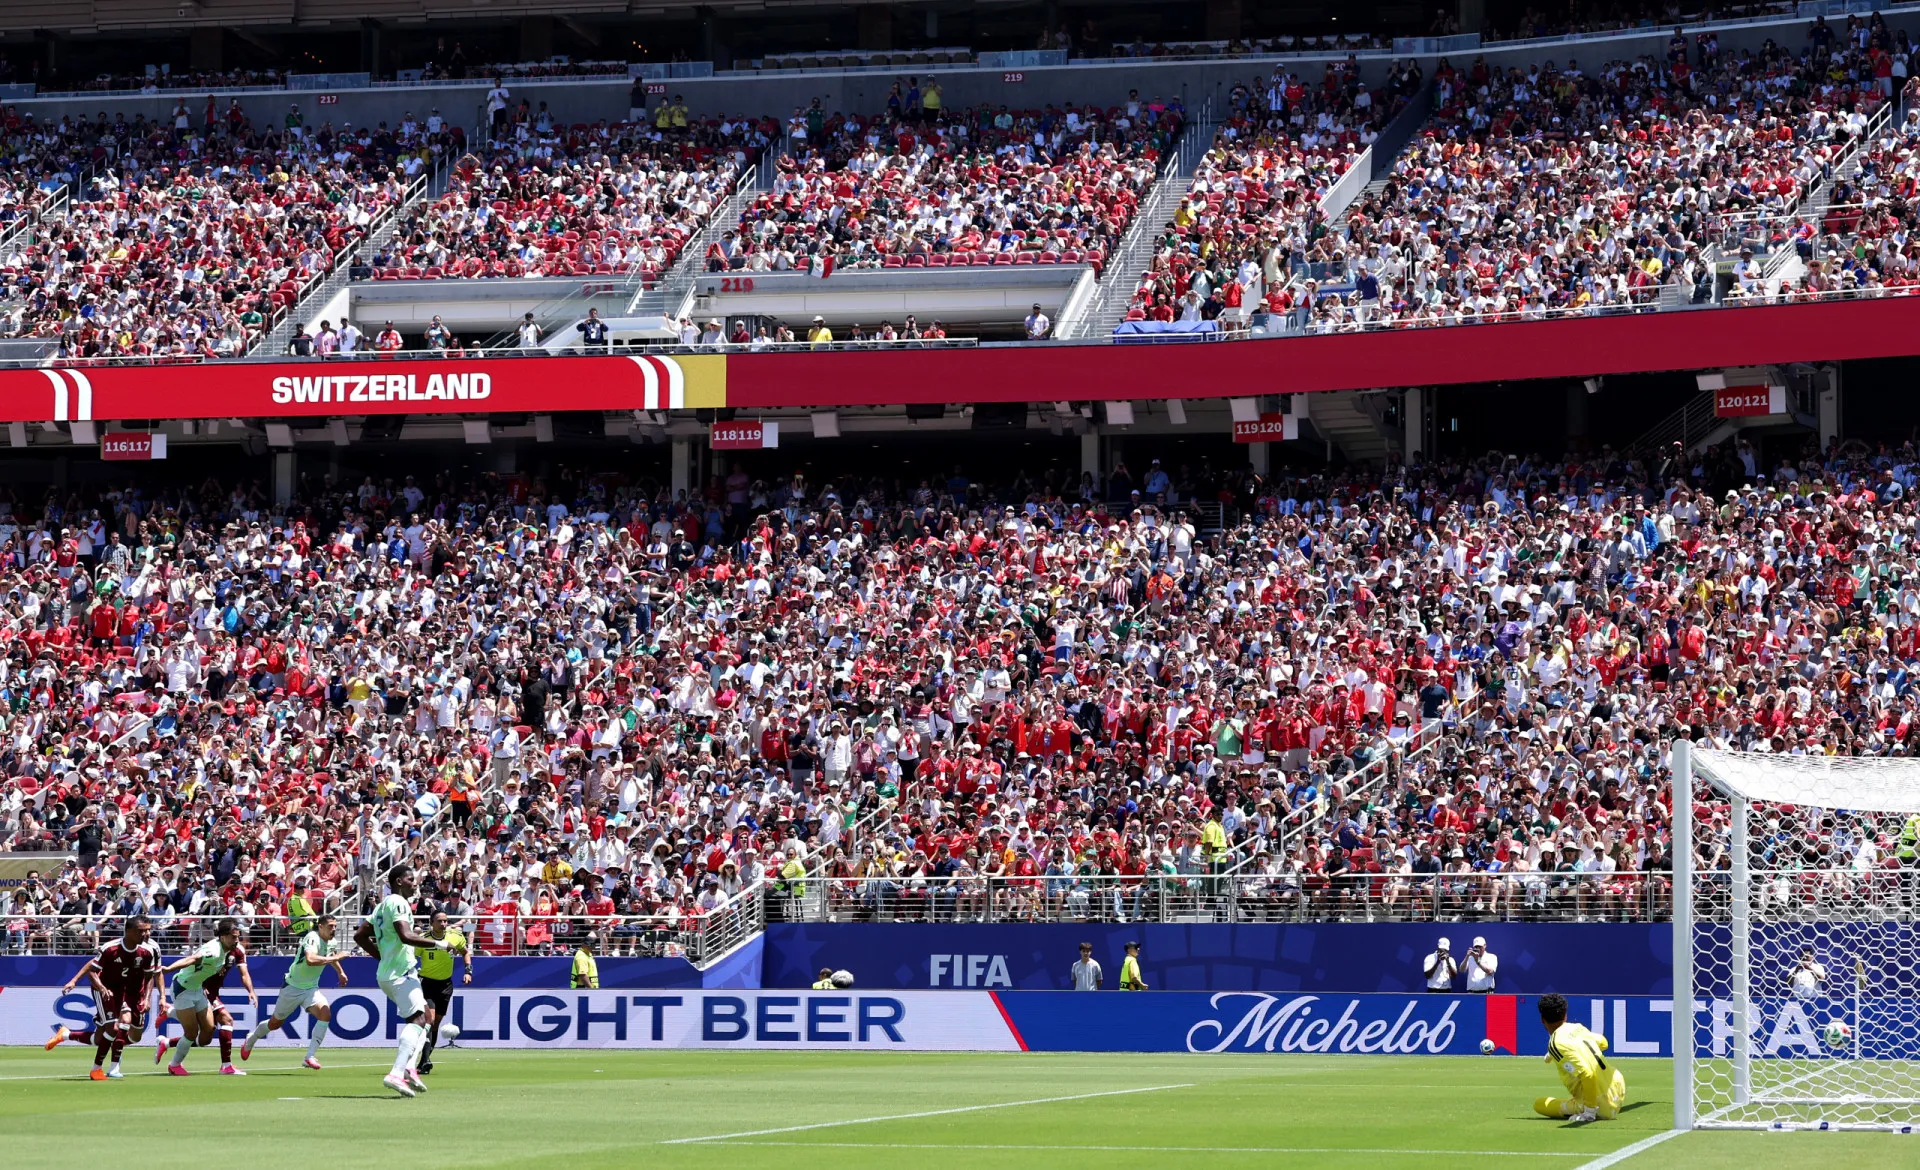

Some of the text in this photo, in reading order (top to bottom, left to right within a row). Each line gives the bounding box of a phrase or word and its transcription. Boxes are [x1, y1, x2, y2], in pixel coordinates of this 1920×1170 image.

[1004, 73, 1023, 82] 219
[647, 85, 665, 94] 218
[320, 95, 337, 104] 217
[720, 277, 754, 292] 219
[272, 372, 491, 404] SWITZERLAND
[1718, 395, 1768, 408] 120 121
[1236, 422, 1282, 434] 119 120
[713, 430, 761, 441] 118 119
[105, 441, 150, 452] 116 117
[551, 922, 569, 934] 119
[121, 967, 130, 977] 2
[930, 954, 1013, 987] FIFA
[452, 994, 683, 1042] LIGHT
[702, 996, 906, 1043] BEER
[1185, 991, 1461, 1054] Michelob
